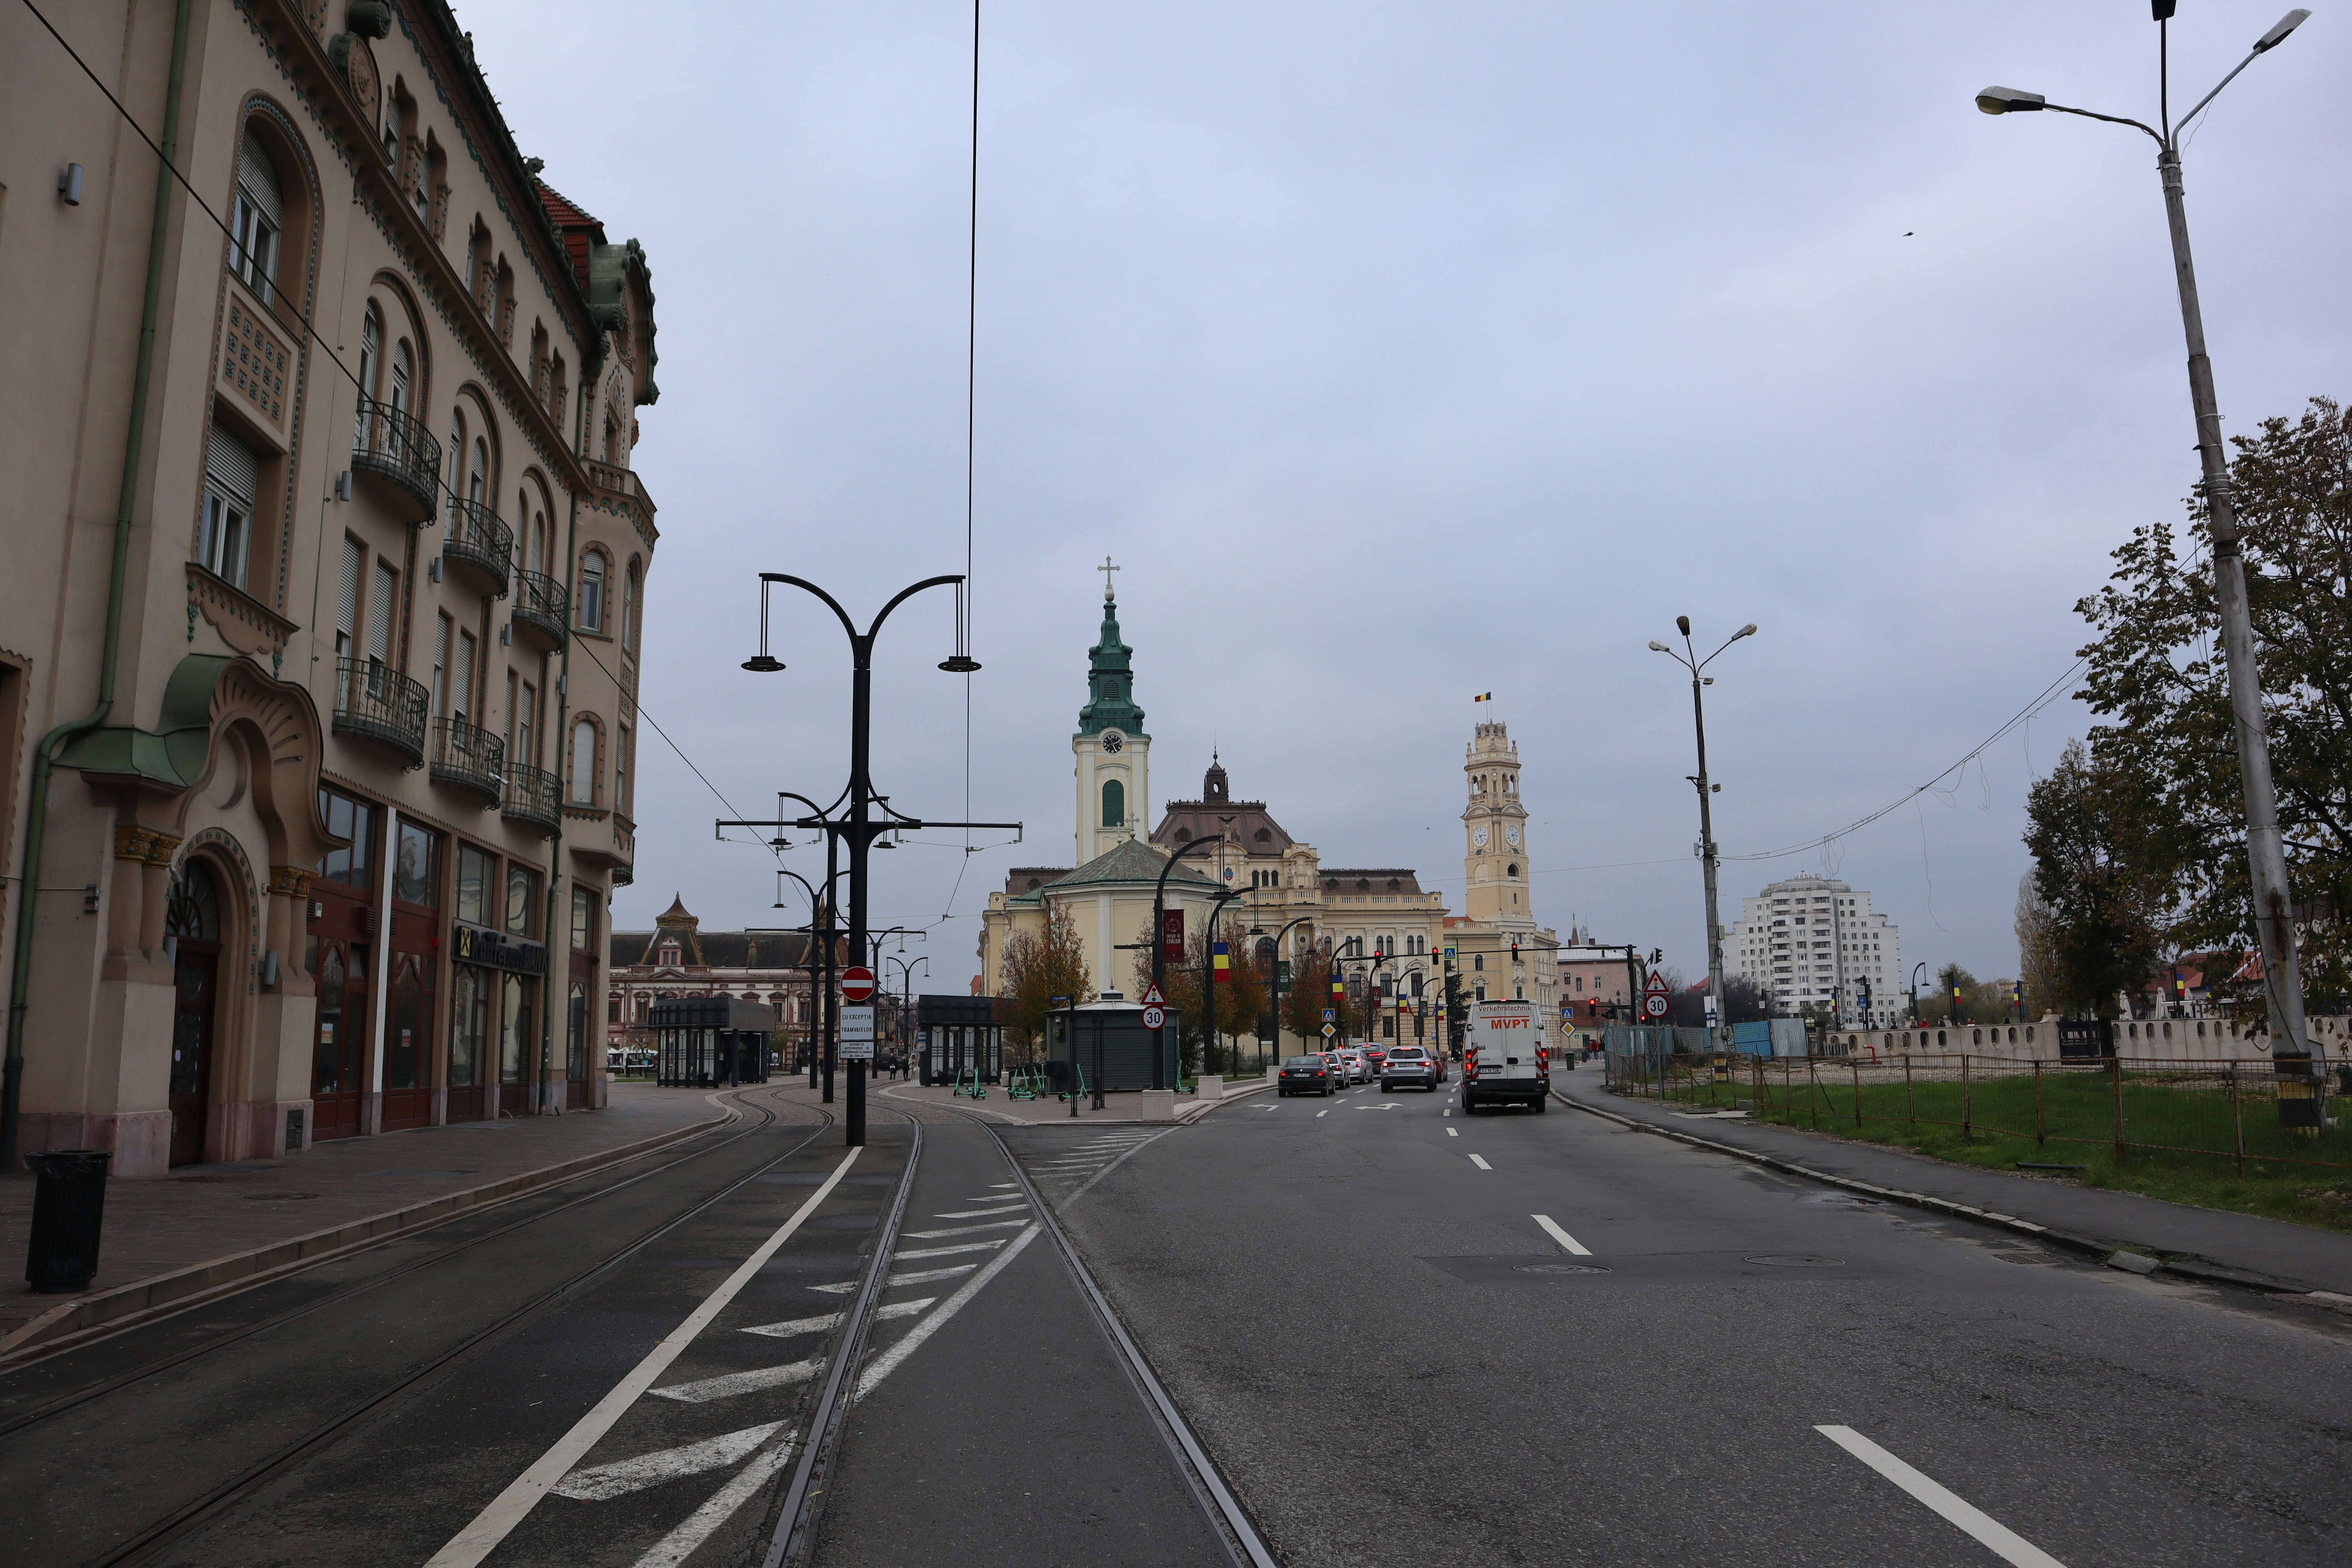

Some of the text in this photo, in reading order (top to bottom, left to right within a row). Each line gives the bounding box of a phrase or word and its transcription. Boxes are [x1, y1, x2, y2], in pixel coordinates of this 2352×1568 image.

[1650, 1000, 1663, 1011] 30
[1147, 1012, 1160, 1024] 30
[1491, 1019, 1530, 1029] MVPT
